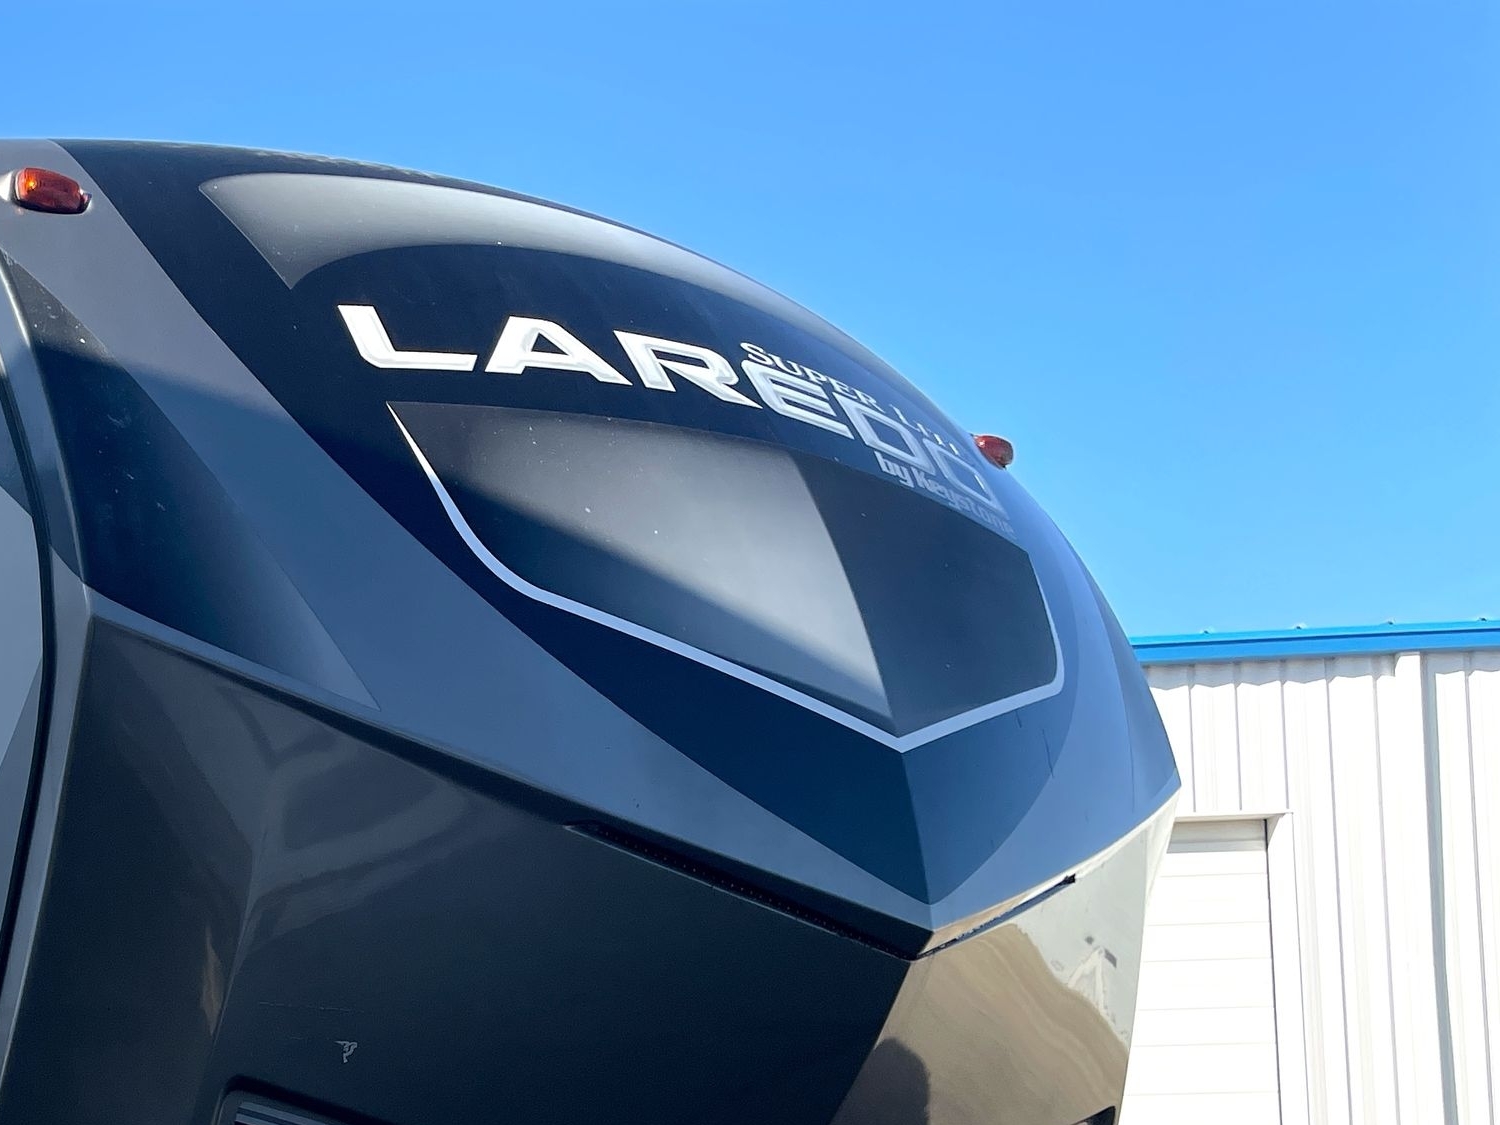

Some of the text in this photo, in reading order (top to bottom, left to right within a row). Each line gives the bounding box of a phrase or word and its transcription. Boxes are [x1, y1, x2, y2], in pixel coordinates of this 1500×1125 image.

[337, 304, 1011, 521] LAREDO
[739, 341, 887, 414] SUPER
[873, 450, 916, 489] by
